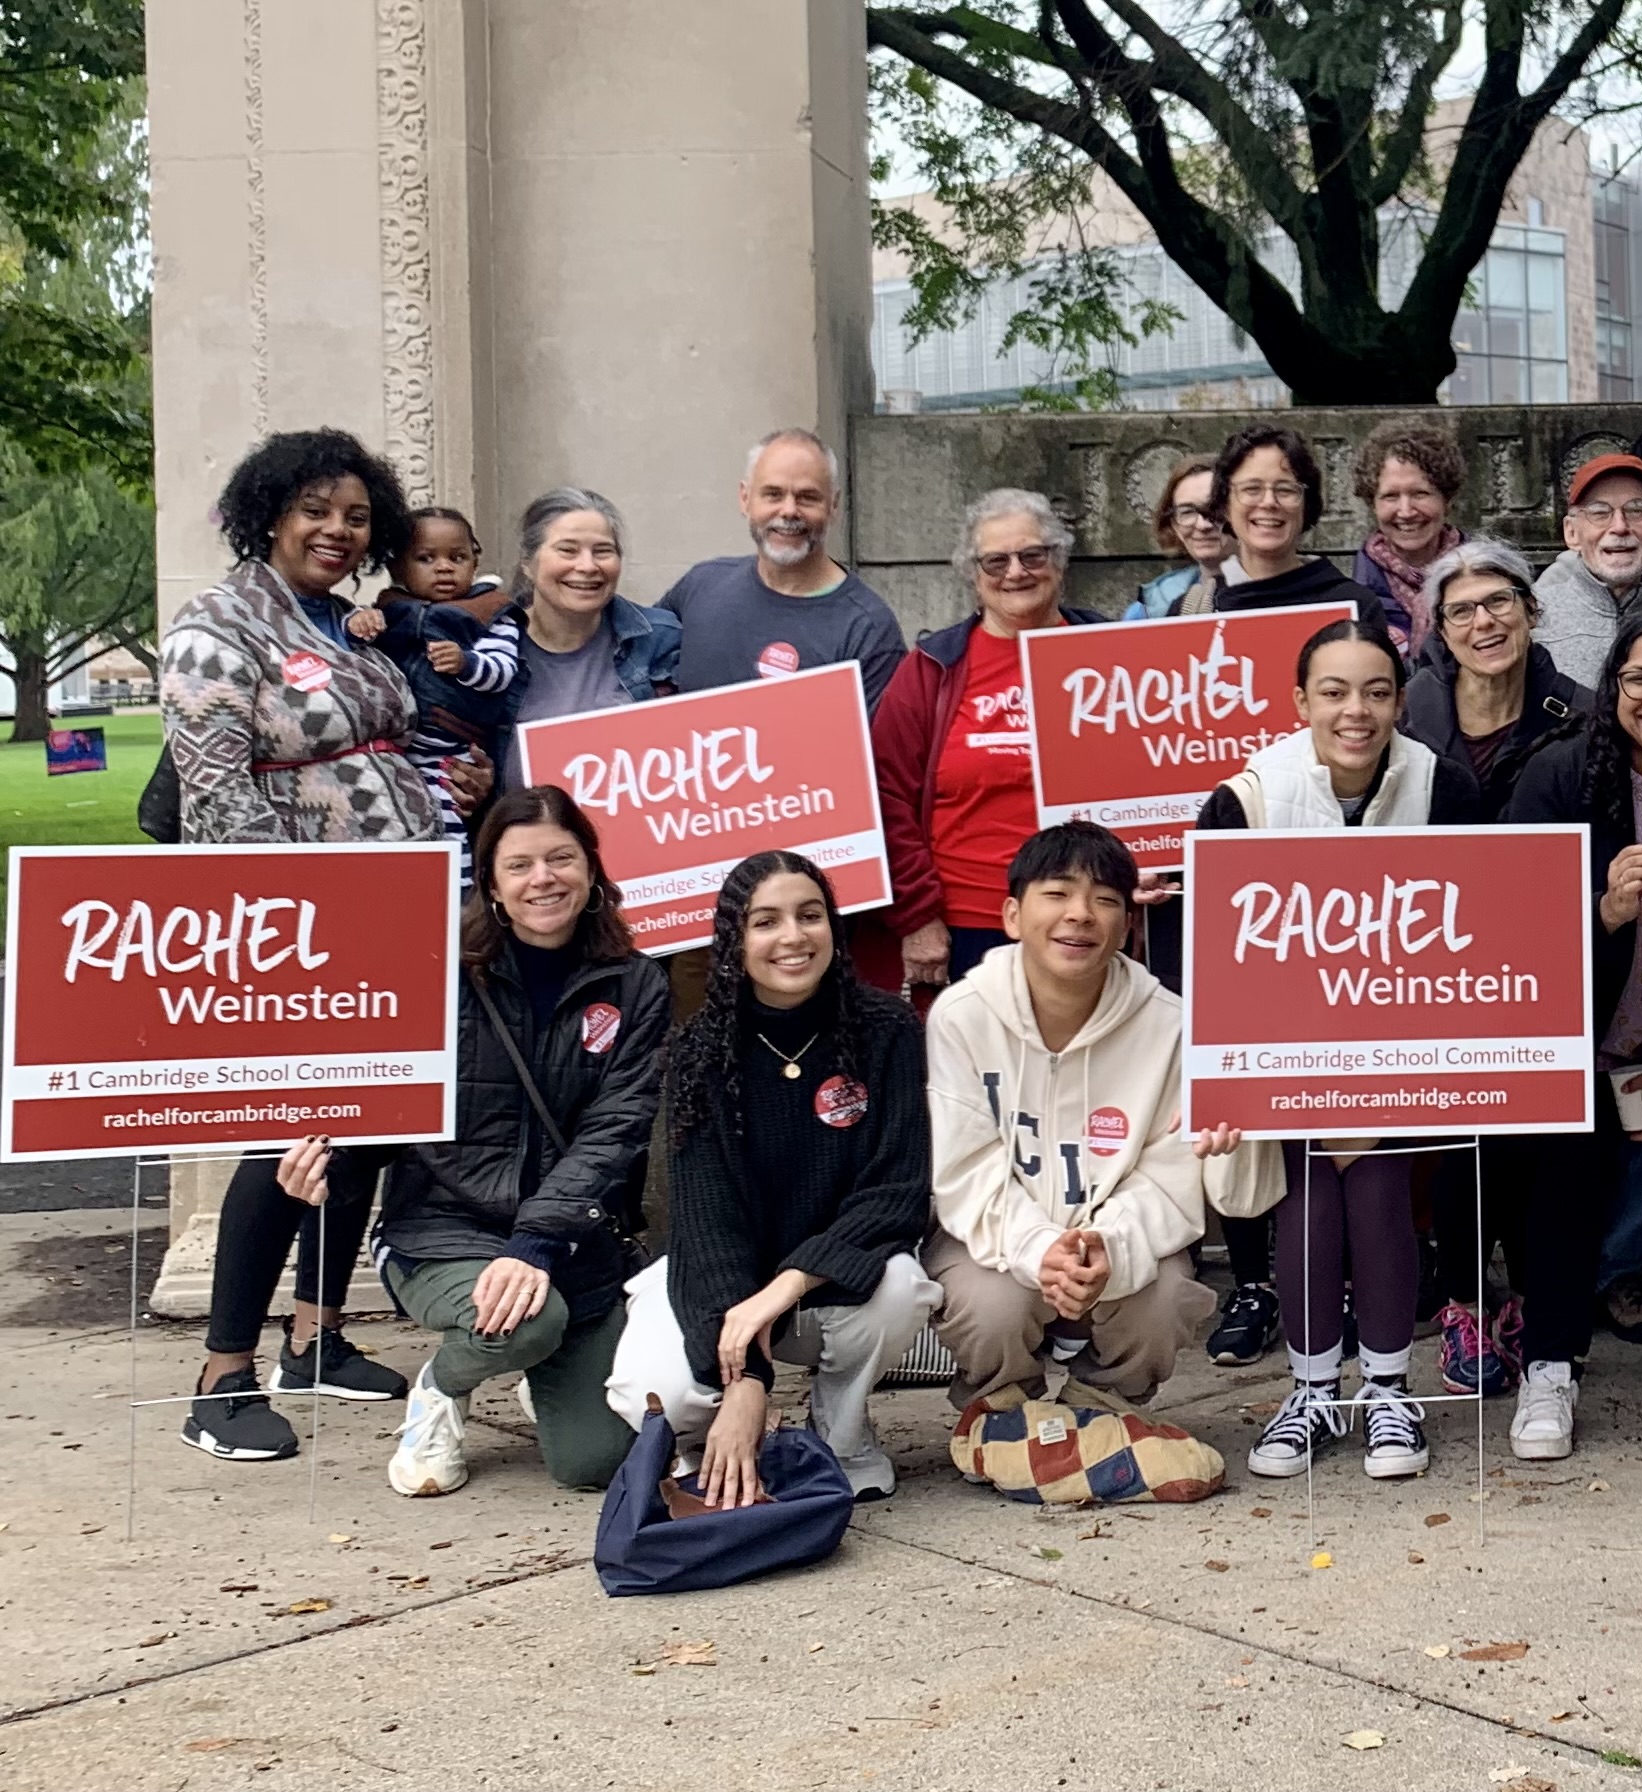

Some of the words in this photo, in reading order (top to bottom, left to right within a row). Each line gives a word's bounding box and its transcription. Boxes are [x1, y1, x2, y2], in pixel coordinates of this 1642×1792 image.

[970, 686, 1027, 722] RAC
[1061, 648, 1269, 737] RACHEL
[1141, 721, 1303, 767] Weinst
[562, 726, 775, 817] RACHEL
[645, 783, 835, 845] Weinstein
[1100, 801, 1190, 822] Cambridge
[620, 876, 696, 901] mbridge
[61, 892, 330, 984] RACHEL
[1231, 873, 1473, 964] RACHEL
[158, 980, 398, 1025] Weinstein
[1318, 963, 1539, 1006] Weinstein
[48, 1070, 80, 1091] #1
[88, 1066, 210, 1094] Cambridge
[216, 1062, 289, 1085] School
[297, 1059, 414, 1081] Committee
[1221, 1051, 1250, 1072] #1
[1256, 1049, 1366, 1071] Cambridge
[1372, 1047, 1440, 1067] School
[1446, 1046, 1556, 1066] Committee
[103, 1100, 362, 1128] rachelforcambridge.com
[1271, 1087, 1508, 1110] rachelforcambridge.com
